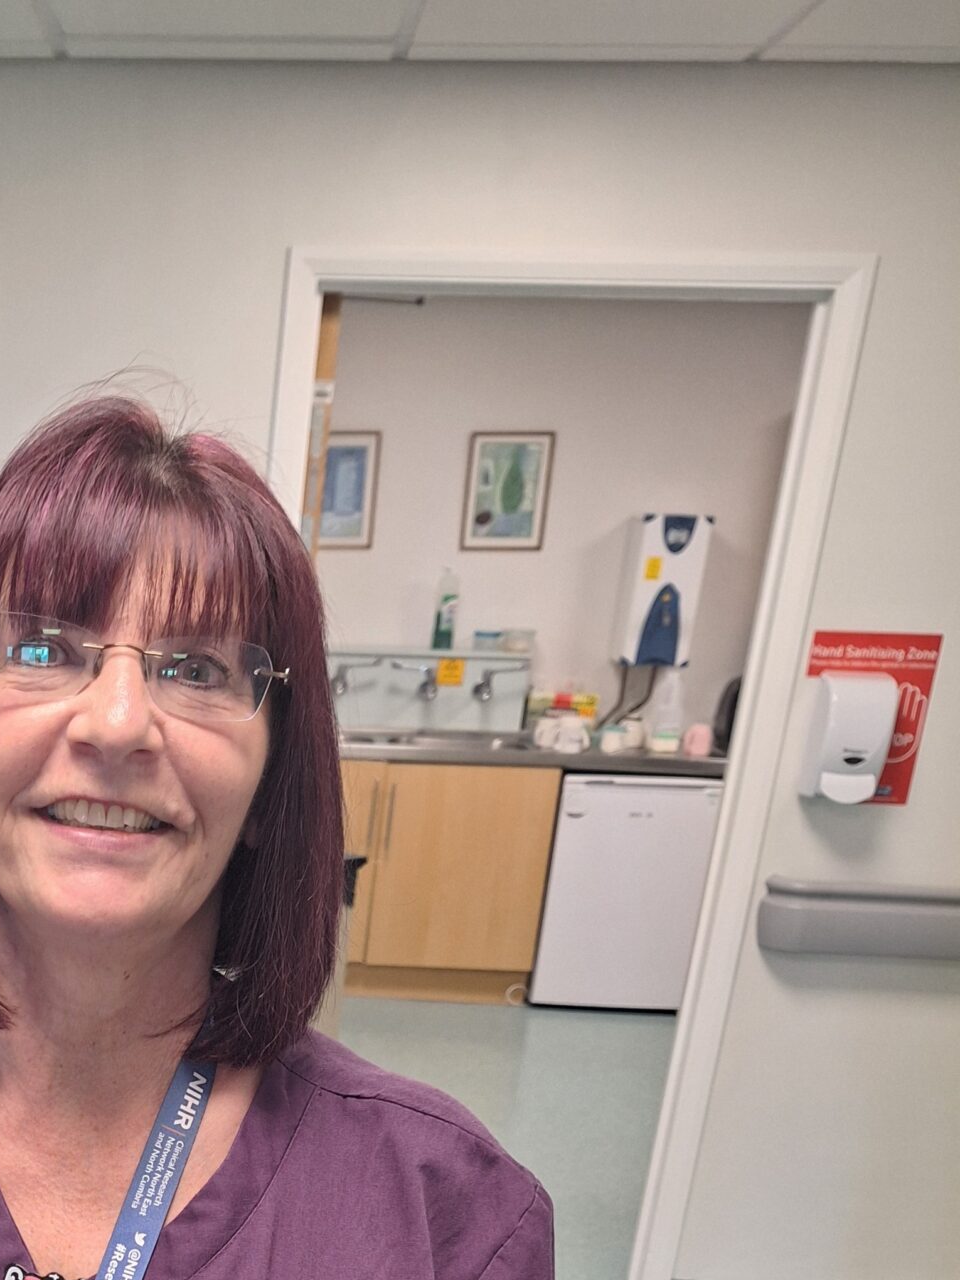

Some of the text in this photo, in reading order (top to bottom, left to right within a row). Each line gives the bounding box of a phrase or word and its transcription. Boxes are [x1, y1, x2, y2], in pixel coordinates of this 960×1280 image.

[173, 1072, 208, 1131] NIHR
[130, 1131, 164, 1208] and North Cumbria
[138, 1136, 175, 1216] Network North East
[152, 1140, 184, 1206] Clinical Research
